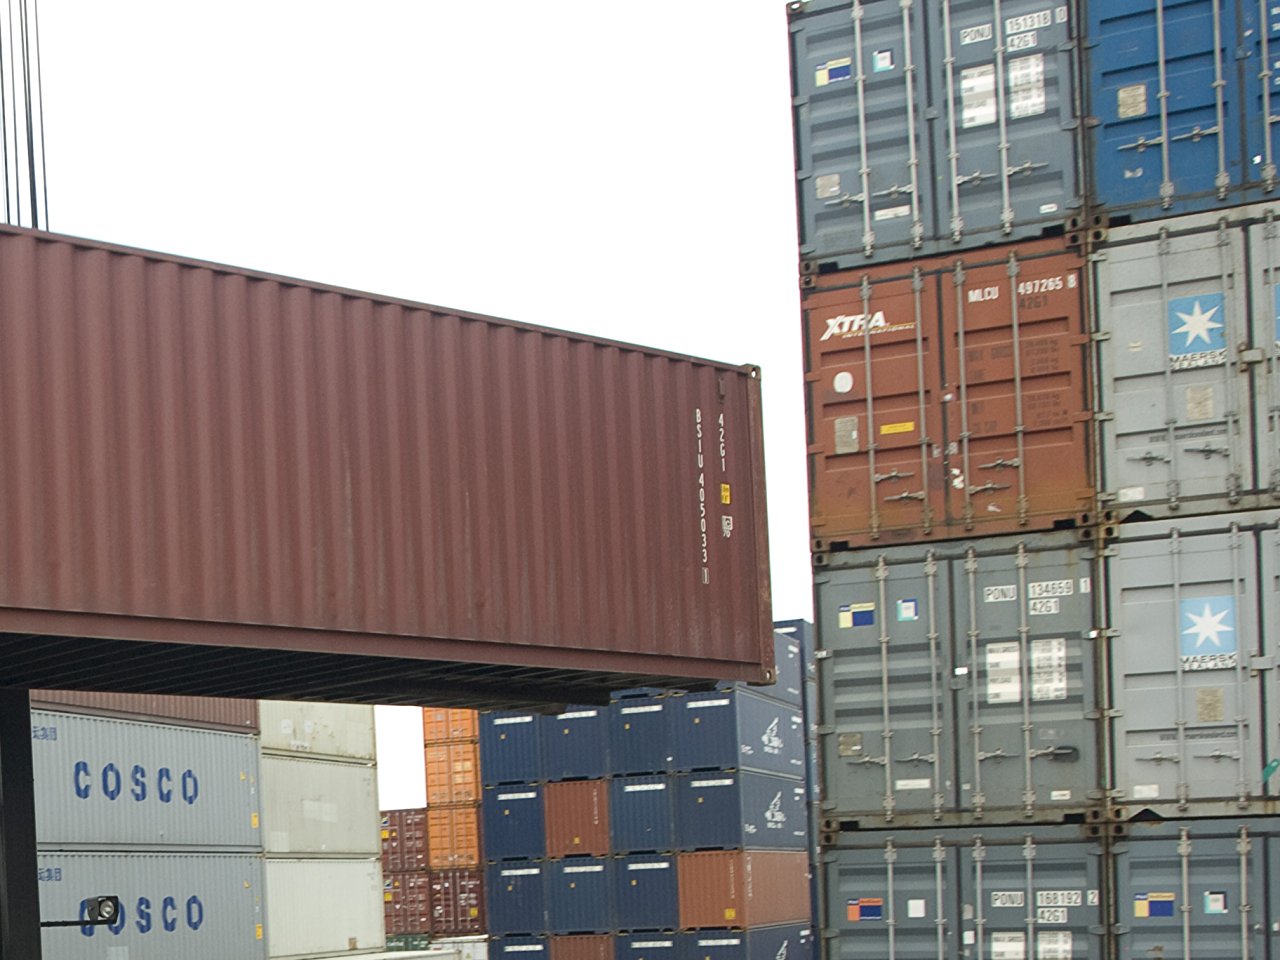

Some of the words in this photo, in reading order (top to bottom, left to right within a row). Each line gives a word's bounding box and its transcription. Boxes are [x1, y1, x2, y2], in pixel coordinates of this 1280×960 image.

[961, 24, 992, 43] PONU
[968, 286, 999, 303] MLCU
[695, 408, 704, 469] BSIU
[985, 586, 1017, 602] PONU
[73, 760, 199, 804] COSCO
[992, 892, 1024, 906] PONU
[1038, 891, 1081, 906] 168192
